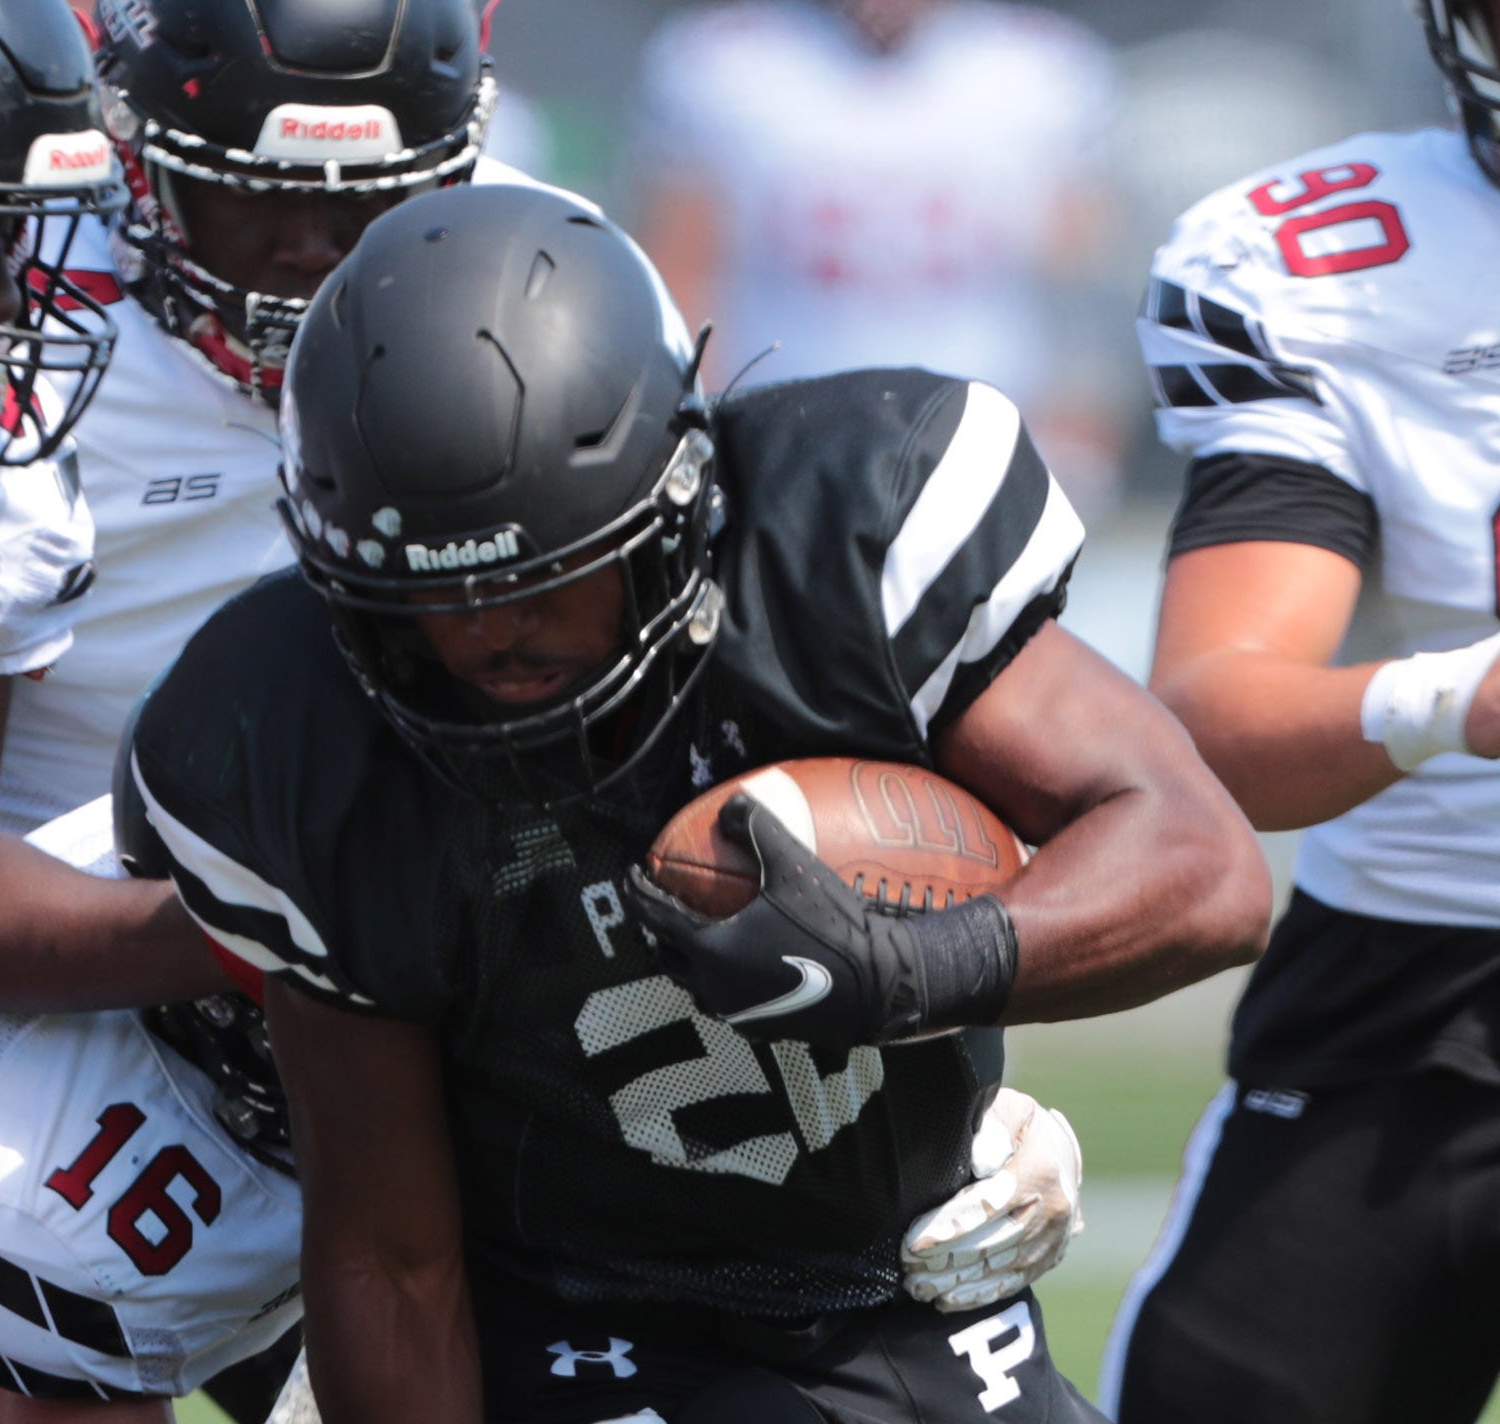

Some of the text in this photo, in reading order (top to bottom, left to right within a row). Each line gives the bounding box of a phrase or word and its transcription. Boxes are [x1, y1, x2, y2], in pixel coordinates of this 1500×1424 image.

[282, 117, 381, 140] Riddell
[1247, 162, 1410, 278] 90
[404, 529, 519, 571] Riddell
[47, 1101, 222, 1277] 16
[948, 1301, 1037, 1413] P
